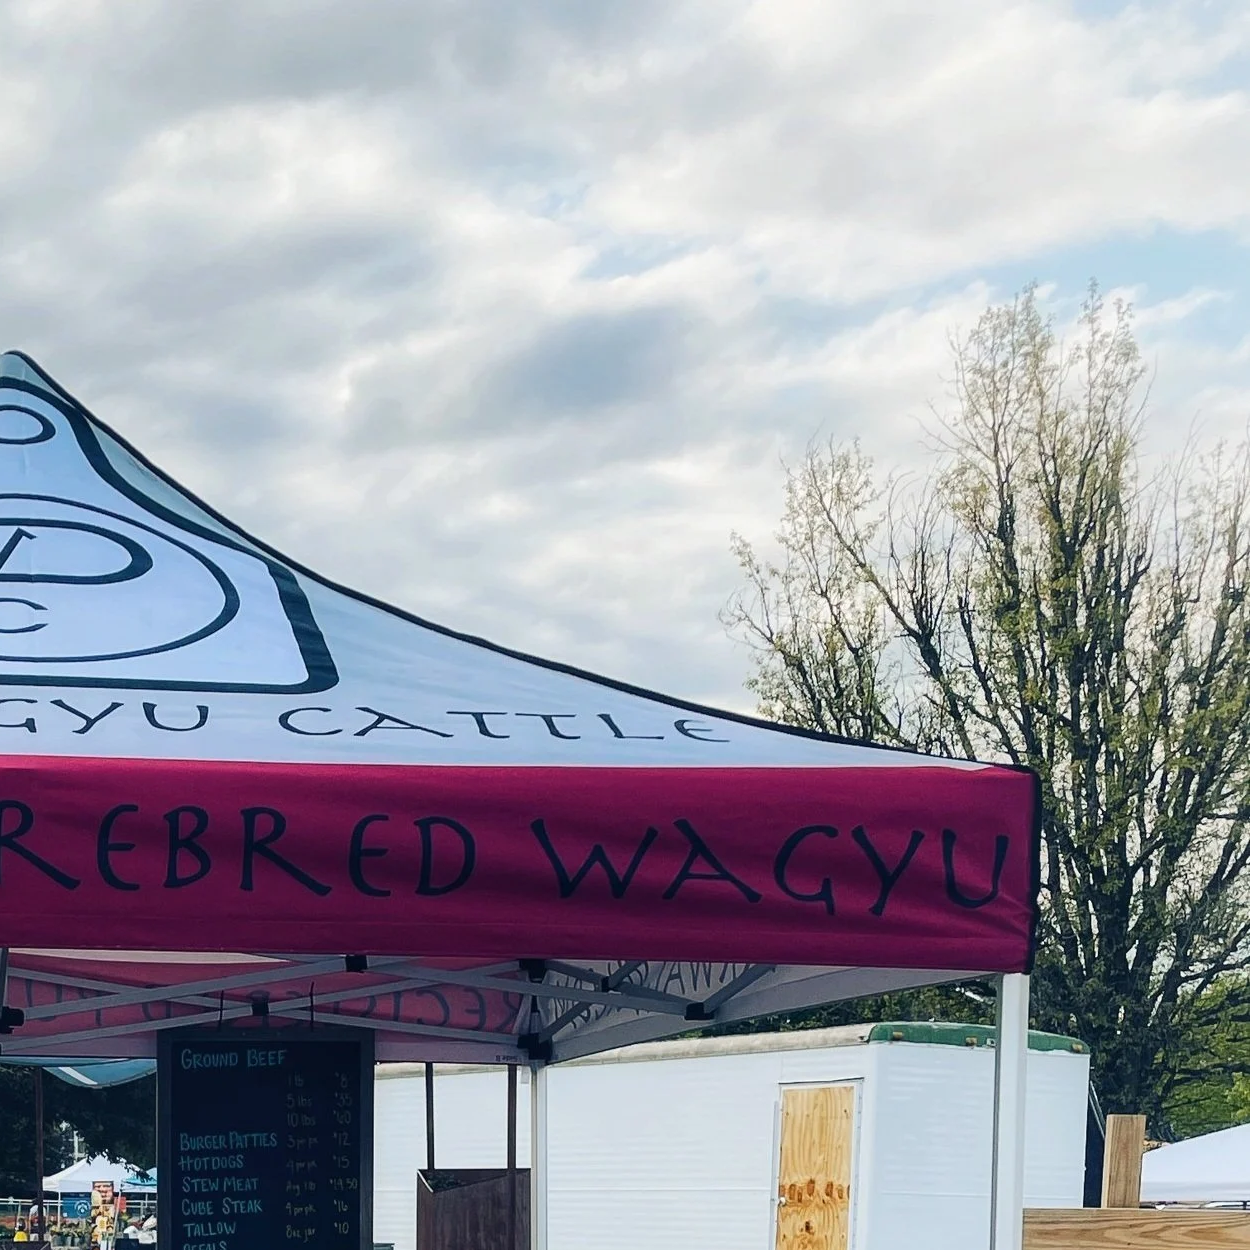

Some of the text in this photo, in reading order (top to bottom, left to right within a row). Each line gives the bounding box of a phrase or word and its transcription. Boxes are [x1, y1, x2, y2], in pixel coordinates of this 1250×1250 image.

[278, 706, 731, 743] CATTLE
[529, 817, 1011, 917] WAGYU
[181, 1049, 287, 1070] GROUND BEEF
[180, 1131, 277, 1151] BURGER PATTIES
[182, 1176, 259, 1193] STEW MEAT
[182, 1197, 263, 1215] CUBE STEAK
[183, 1221, 236, 1237] TALLOW
